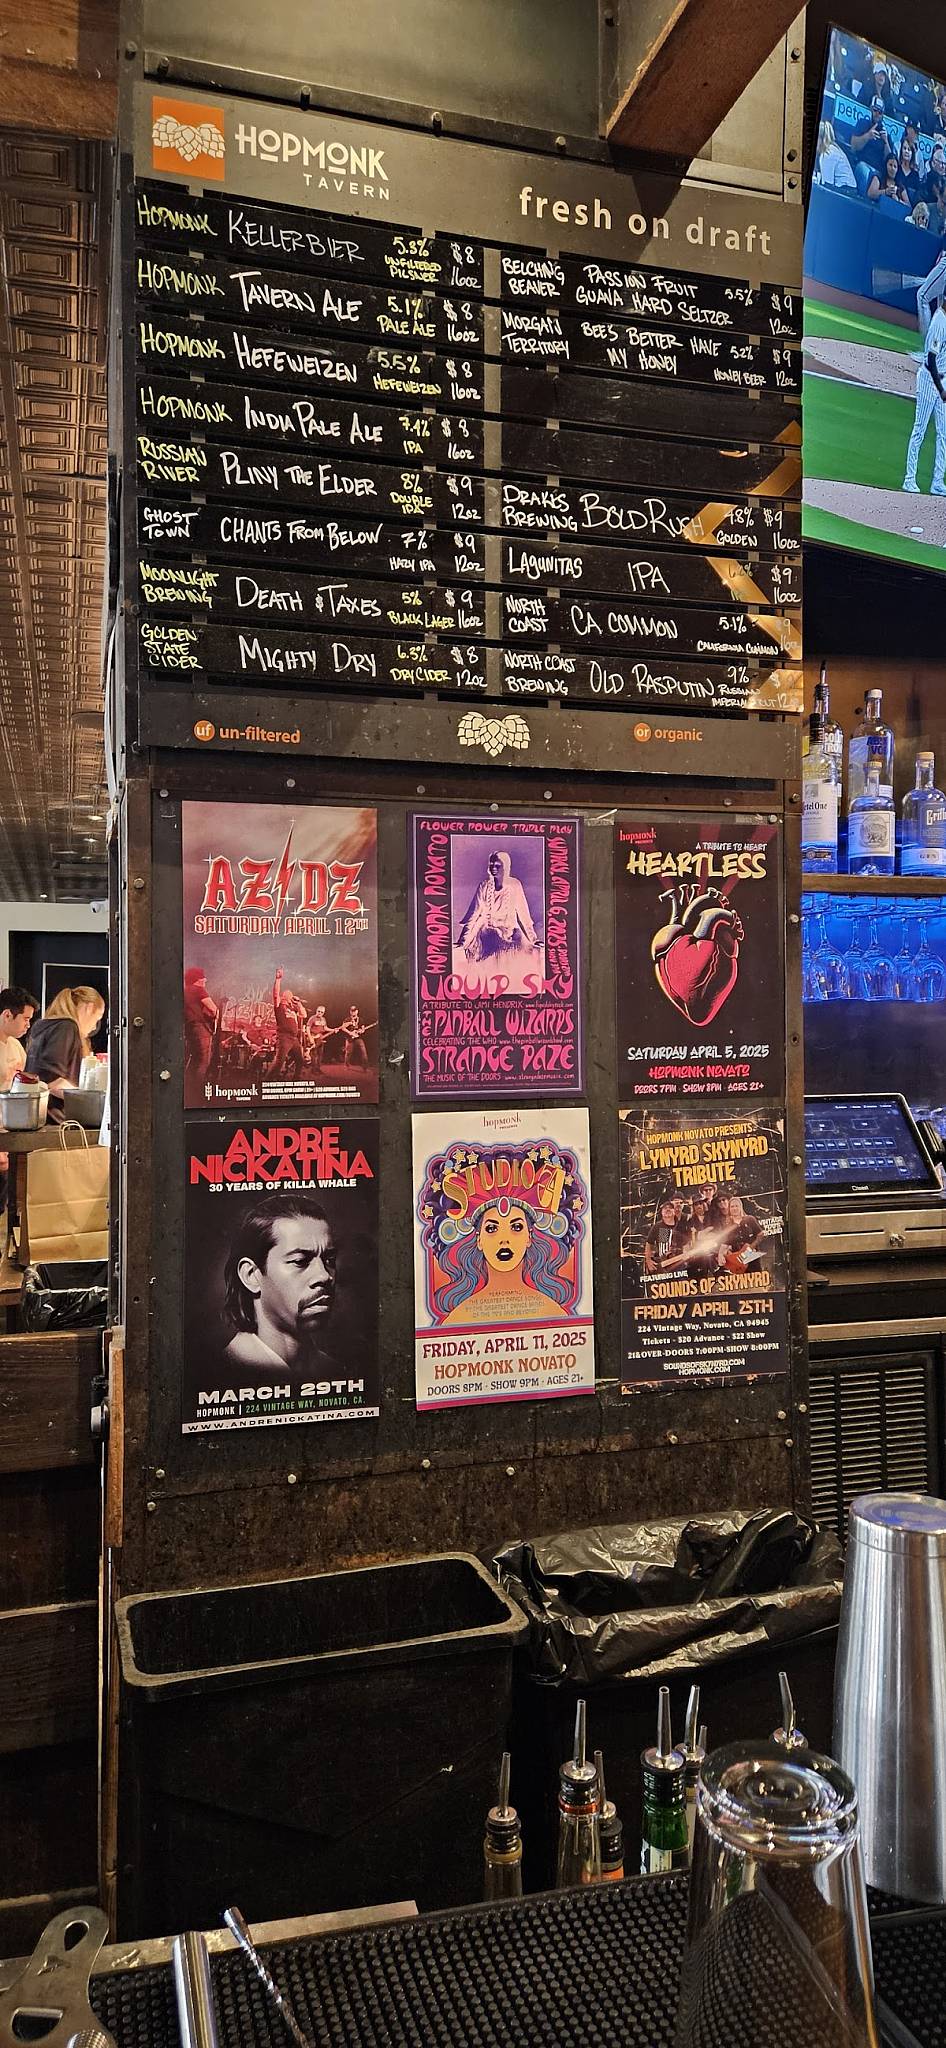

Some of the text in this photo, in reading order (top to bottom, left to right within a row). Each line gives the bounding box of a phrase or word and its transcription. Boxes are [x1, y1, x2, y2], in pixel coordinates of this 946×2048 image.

[235, 123, 388, 180] HOPMONK
[303, 173, 390, 200] TAVERN
[137, 194, 217, 236] HOPMONK
[393, 236, 429, 257] 5.3%
[519, 186, 771, 256] fresh on draft
[138, 259, 423, 322] HOPMONK TAVERN ALE 5.1%
[651, 275, 698, 298] FRUIT
[508, 278, 733, 325] BEAVER HARD SELTZER
[377, 315, 436, 337] PALE ALE
[502, 309, 722, 357] MORGAN BETTER HAVE
[140, 323, 421, 383] HOPMONK HEFEWEIZEN 5.5%
[502, 332, 677, 375] TERRITORY MY HONEY
[373, 373, 442, 395] HEFEWEIZEN
[742, 372, 767, 387] BEER
[140, 386, 232, 423] HOPMONK
[245, 396, 295, 432] INDIA
[292, 401, 340, 438] PALE
[350, 412, 382, 444] ALE
[403, 440, 423, 455] IPA
[137, 436, 423, 496] RUSSIAN PLINY THE ELDER 8%
[141, 461, 199, 482] RIVER
[579, 493, 648, 530] BOLD
[143, 507, 428, 551] GHOST CHANTS FROM BELOW 7%
[502, 505, 758, 547] BREWING GOLDEN
[143, 523, 436, 572] TOWN HAZY IPA
[508, 547, 670, 594] LAGUNITAS IPA
[139, 561, 423, 617] MOONLIGHT DEATH TAXES 5%
[141, 584, 456, 629] BREWING BLACK LAGER
[505, 595, 748, 640] NORTH CA COMMON 5.1%
[508, 616, 549, 633] COAST
[141, 623, 428, 677] GOLDEN MIGHTY DRY 6.3%
[143, 640, 190, 655] STATE
[148, 653, 452, 683] CIDER CIDER
[504, 651, 714, 698] NORTH COAST OLD RASPUTIN
[505, 676, 569, 696] BREWING
[195, 725, 301, 744] uf un-filtered
[637, 728, 703, 743] or organic
[420, 821, 509, 833] FLOWER POWER
[619, 827, 657, 844] hopmonk
[702, 842, 732, 851] TRIBUTE
[626, 850, 767, 879] HEARTLESS
[424, 834, 450, 974] HOPMONK NOVATO
[194, 914, 369, 937] SATURDAY APRIL 12TH
[420, 973, 574, 1000] LIQUID SKY
[429, 1001, 462, 1009] TRIBUTE
[493, 1001, 524, 1009] HENDRIX
[434, 1008, 575, 1036] PINBALL WIZARDS
[423, 1037, 466, 1046] CELEBRATING
[627, 1044, 770, 1061] SATURDAY APRIL 2025
[422, 1045, 575, 1073] STRANGE DAZE
[649, 1064, 751, 1079] HOPMONK NOVATO
[437, 1073, 455, 1082] MUSIC
[481, 1073, 501, 1081] DOORS
[634, 1084, 658, 1094] DOORS
[215, 1083, 259, 1100] hopmonk
[483, 1112, 521, 1130] hopmonk
[225, 1126, 340, 1158] ANDRE
[646, 1131, 684, 1145] HOPMONK
[639, 1135, 768, 1171] LYNYRD SKYNYRD
[190, 1150, 374, 1184] NICKATINA
[672, 1160, 736, 1188] TRIBUTE
[209, 1178, 357, 1192] 30 YEARS OF KILLA WHALE
[442, 1158, 535, 1220] STUDIO
[639, 1272, 673, 1283] FEATURING
[650, 1271, 771, 1300] SOUNDS SKYNYRD
[634, 1299, 774, 1320] FRIDAY APRIL 25TH
[642, 1331, 766, 1346] Tickets Advance Show
[653, 1318, 770, 1333] Vintage 94945
[423, 1331, 587, 1359] FRIDAY, APRIL 2025
[434, 1353, 577, 1380] HOPMONK NOVATO
[198, 1379, 365, 1405] MARCH 29TH
[427, 1375, 569, 1396] DOORS 8PM SHOW 9PM AGES
[188, 1410, 375, 1432] WWW.ANDRENICKATINA.COM
[196, 1401, 295, 1418] HOPMONK 224 VINTAGE
